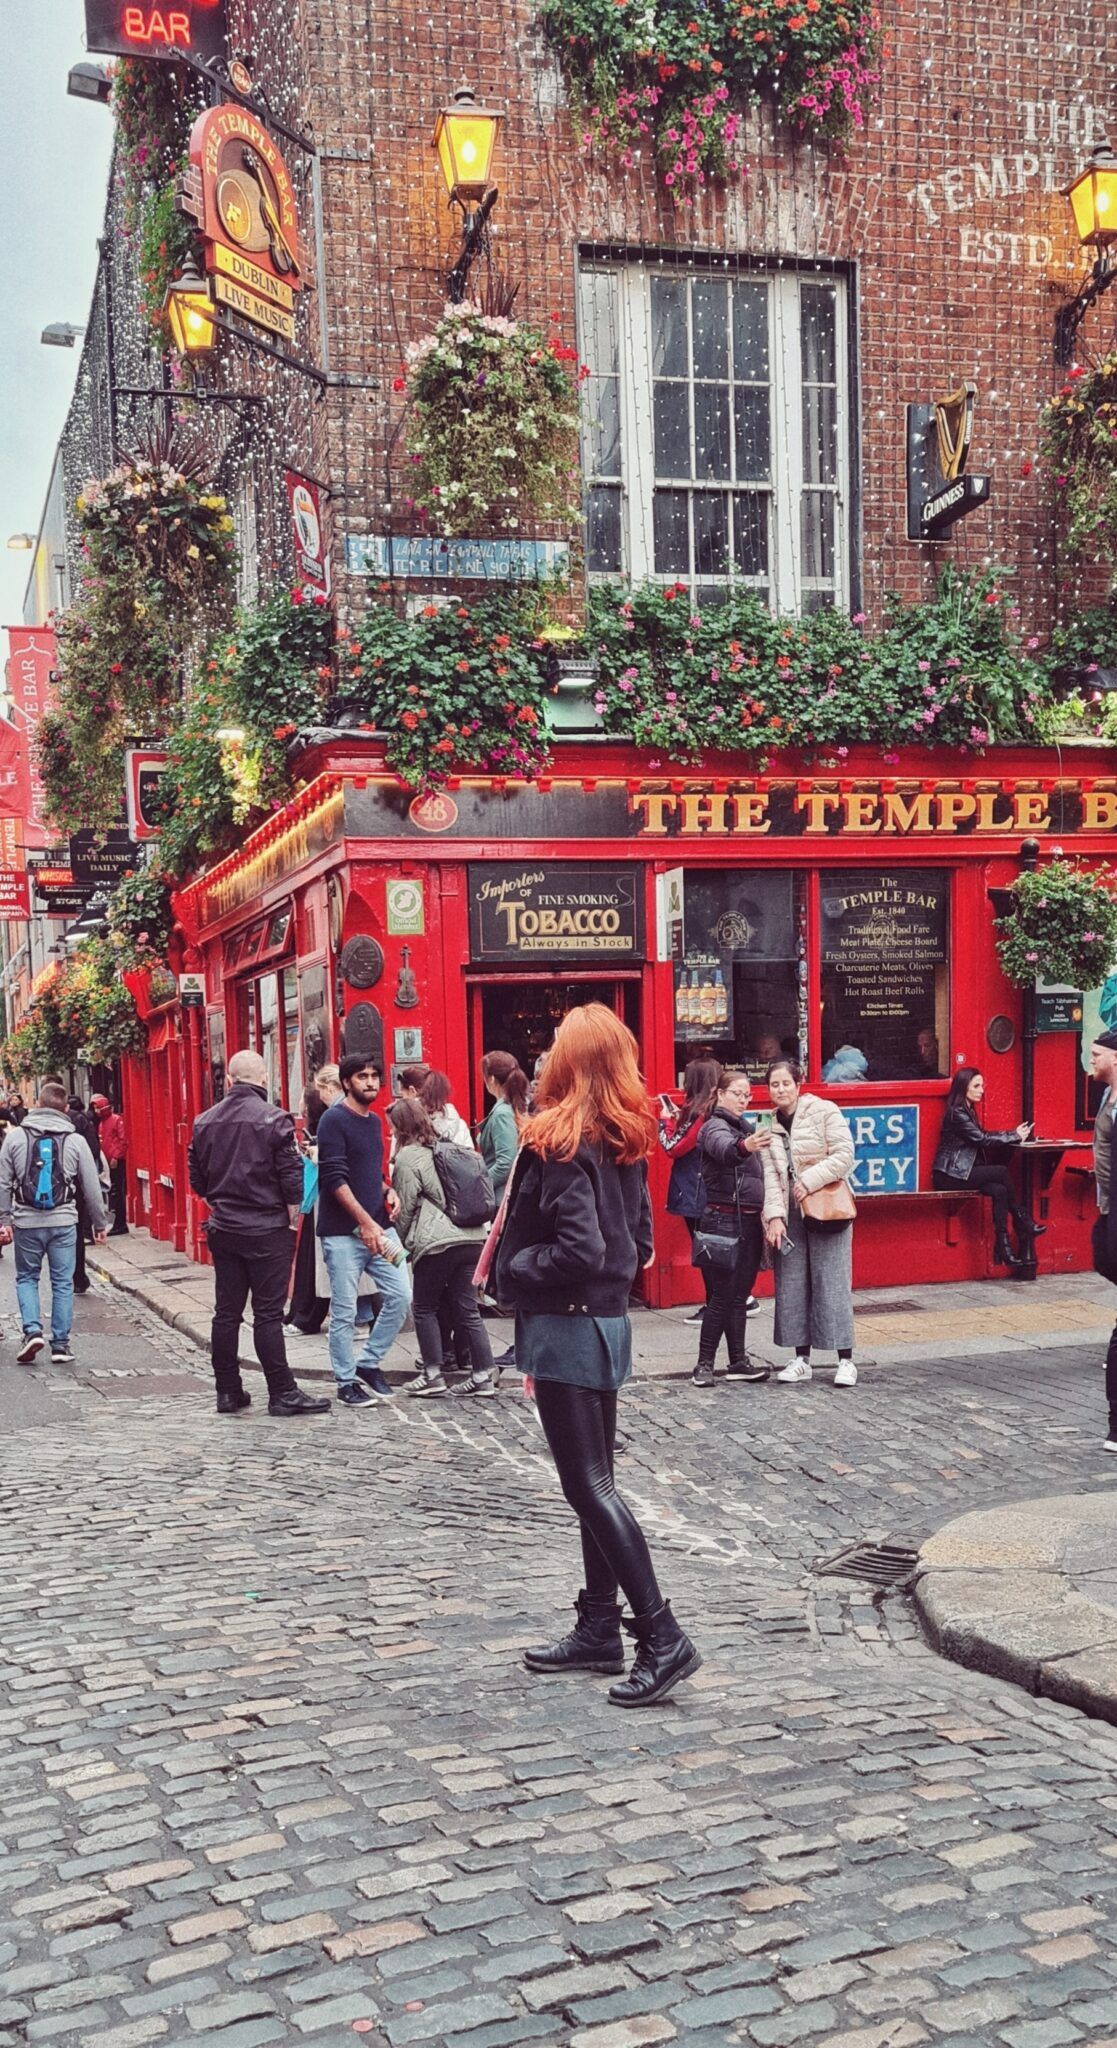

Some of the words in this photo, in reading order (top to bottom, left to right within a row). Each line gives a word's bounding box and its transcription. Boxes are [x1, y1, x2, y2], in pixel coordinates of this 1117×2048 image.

[125, 8, 191, 44] BAR
[1018, 101, 1111, 147] THE
[205, 126, 222, 177] THE
[218, 112, 276, 167] TEMPLE
[277, 169, 294, 226] BAR
[906, 152, 1087, 226] TEMPL
[232, 255, 279, 297] DUBLIN
[224, 283, 252, 312] LIVE
[254, 297, 291, 332] MUSIC
[923, 481, 965, 521] GUINNESS
[21, 659, 38, 696] BAR
[418, 798, 448, 822] 48
[632, 793, 771, 834] THE
[798, 793, 1052, 833] TEMPLE
[101, 854, 131, 862] MUSIC
[0, 883, 25, 891] MPLE
[475, 870, 545, 901] Importers
[880, 877, 898, 887] The
[519, 888, 533, 898] OF
[538, 894, 565, 906] FINE
[566, 893, 619, 906] SMOKING
[839, 890, 902, 910] TEMPLE
[906, 891, 937, 910] BAR
[495, 901, 621, 946] TOBACCO
[892, 924, 911, 934] Food
[913, 924, 930, 933] Fare
[521, 937, 569, 948] Always
[576, 937, 588, 948] in
[592, 936, 631, 948] Stock
[840, 938, 860, 947] Meat
[885, 937, 913, 946] Cheese
[914, 936, 938, 946] Board
[825, 951, 848, 960] Fresh
[848, 950, 880, 961] Oysters,
[882, 949, 913, 959] Smoked
[914, 949, 944, 959] Salmon
[835, 962, 880, 972] Charcuterie
[882, 962, 907, 972] Meats,
[908, 961, 934, 971] Olives
[846, 975, 877, 984] Toasted
[878, 974, 923, 984] Sandwiches
[845, 988, 860, 997] Hot
[861, 987, 883, 996] Roast
[885, 986, 903, 996] Beef
[904, 986, 925, 996] Rolls
